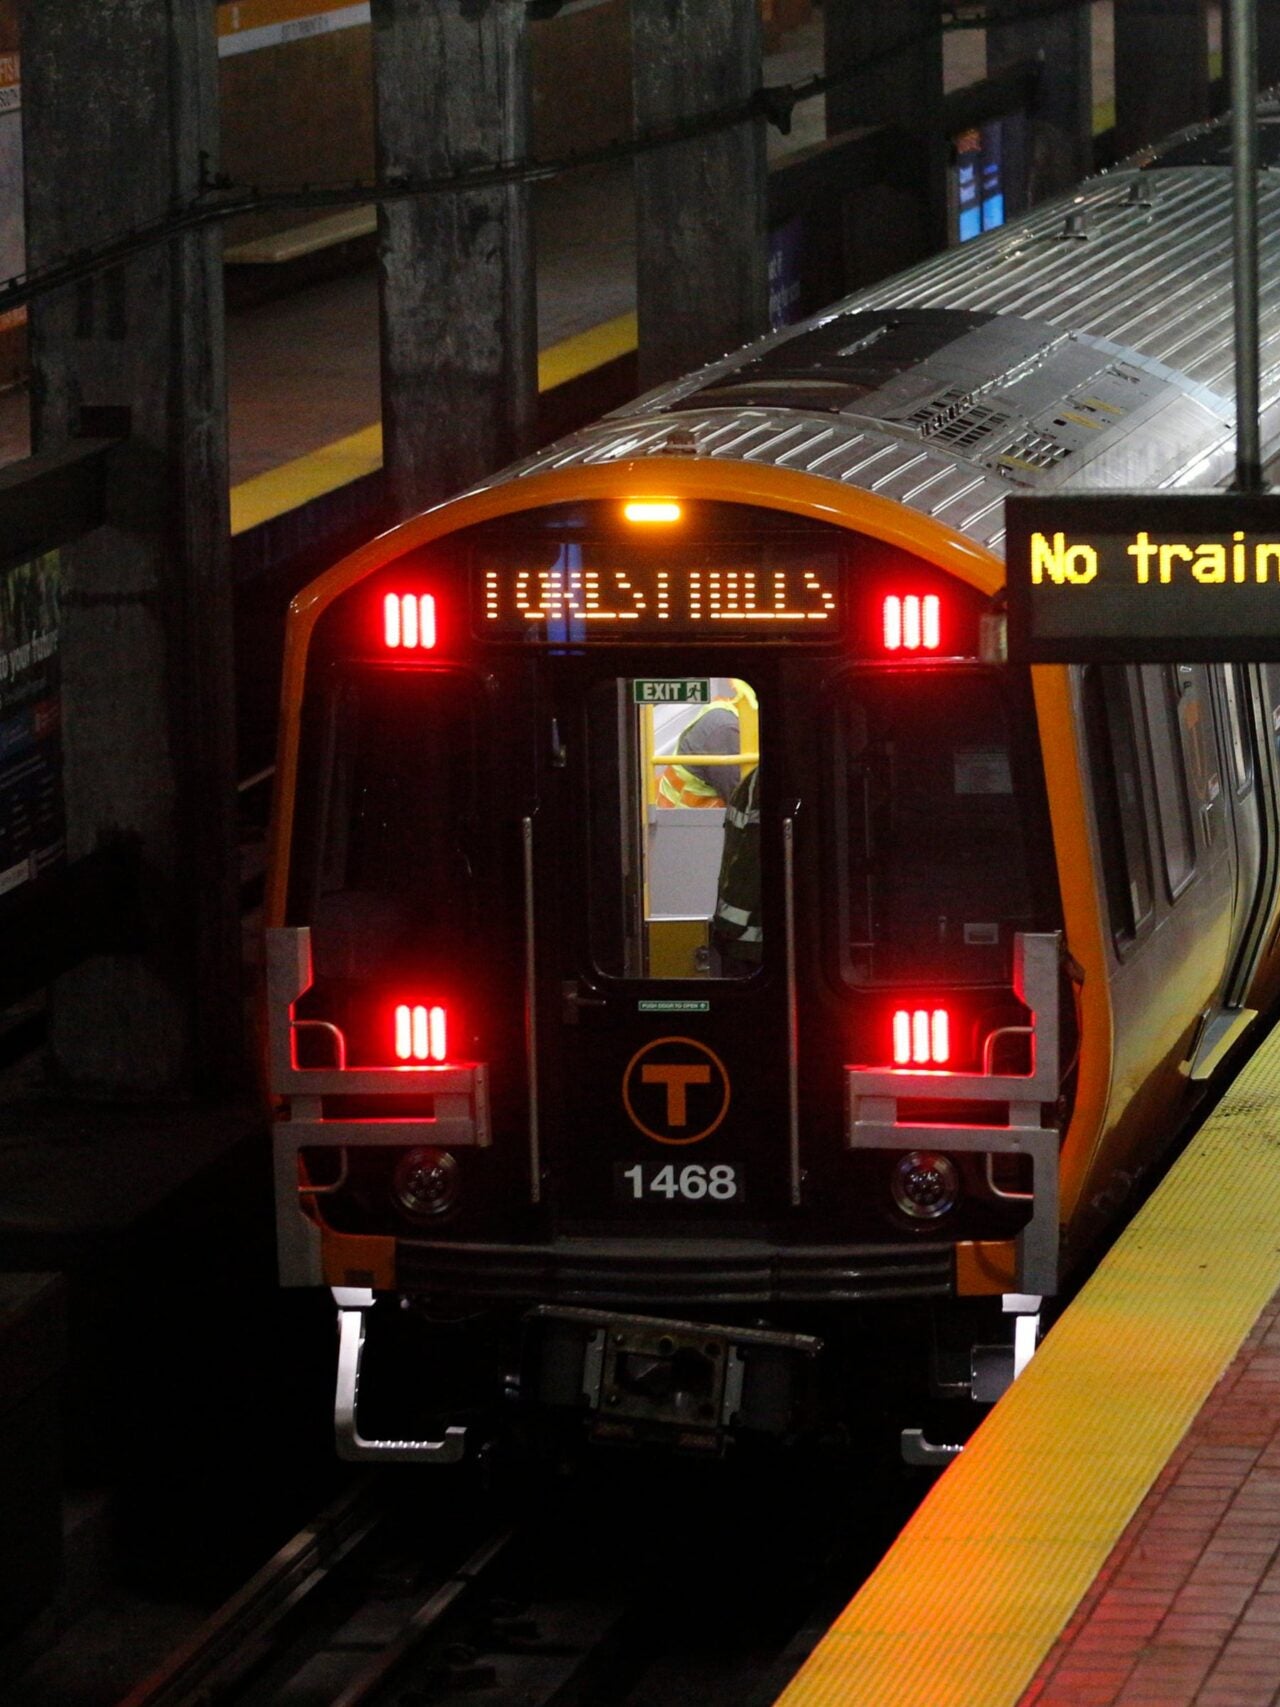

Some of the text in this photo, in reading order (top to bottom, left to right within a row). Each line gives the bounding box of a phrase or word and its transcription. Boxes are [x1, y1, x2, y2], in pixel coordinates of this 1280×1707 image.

[1031, 532, 1098, 584] No
[643, 682, 682, 700] EXIT
[641, 1064, 710, 1127] T
[624, 1164, 737, 1199] 1468
